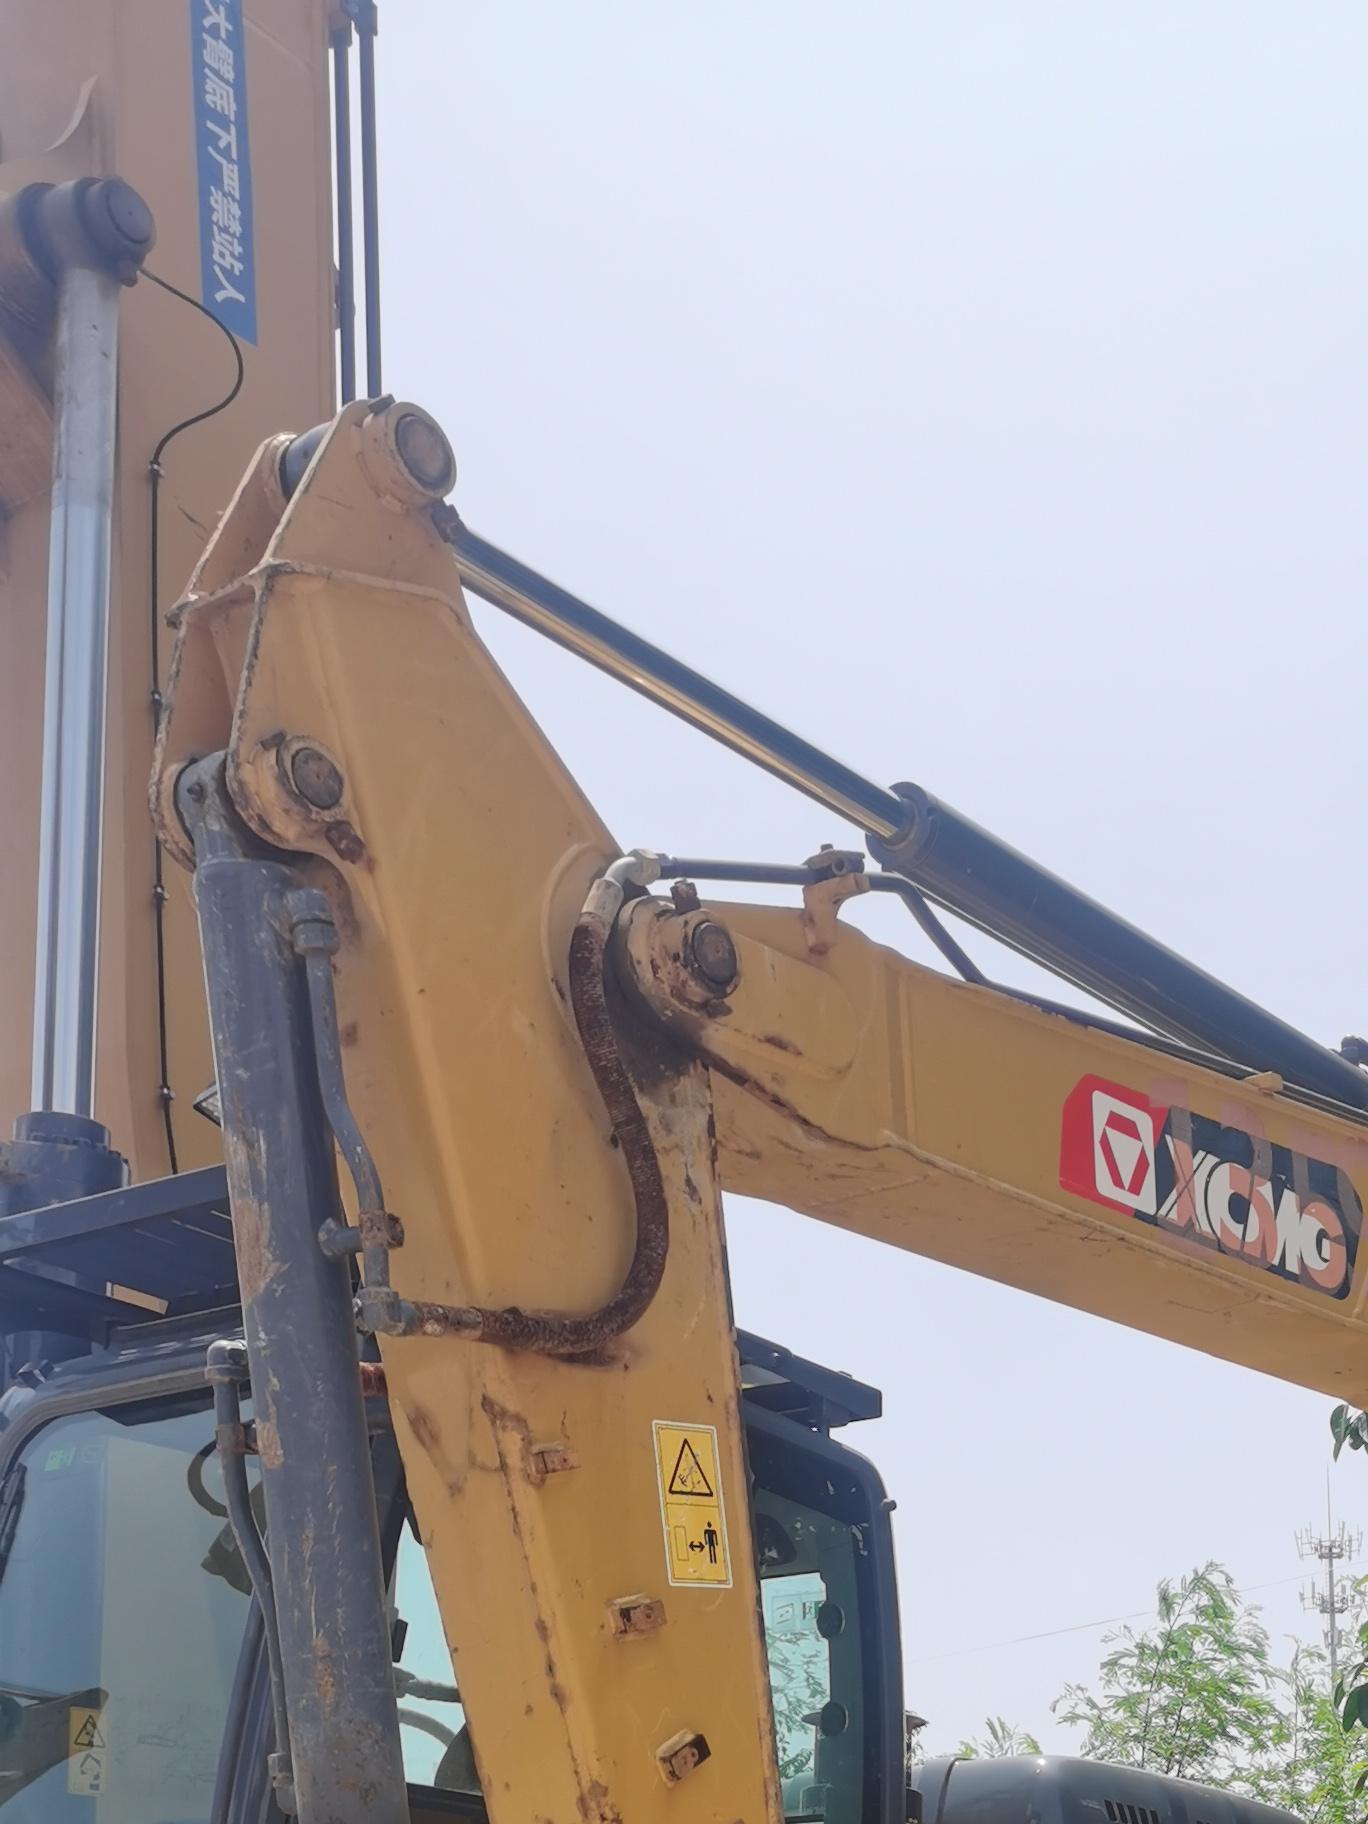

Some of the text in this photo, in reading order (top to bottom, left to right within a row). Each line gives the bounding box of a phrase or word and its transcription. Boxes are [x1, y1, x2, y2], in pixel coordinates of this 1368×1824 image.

[202, 0, 246, 304] 大臂底下严禁站人
[1157, 1134, 1348, 1290] XCMG
